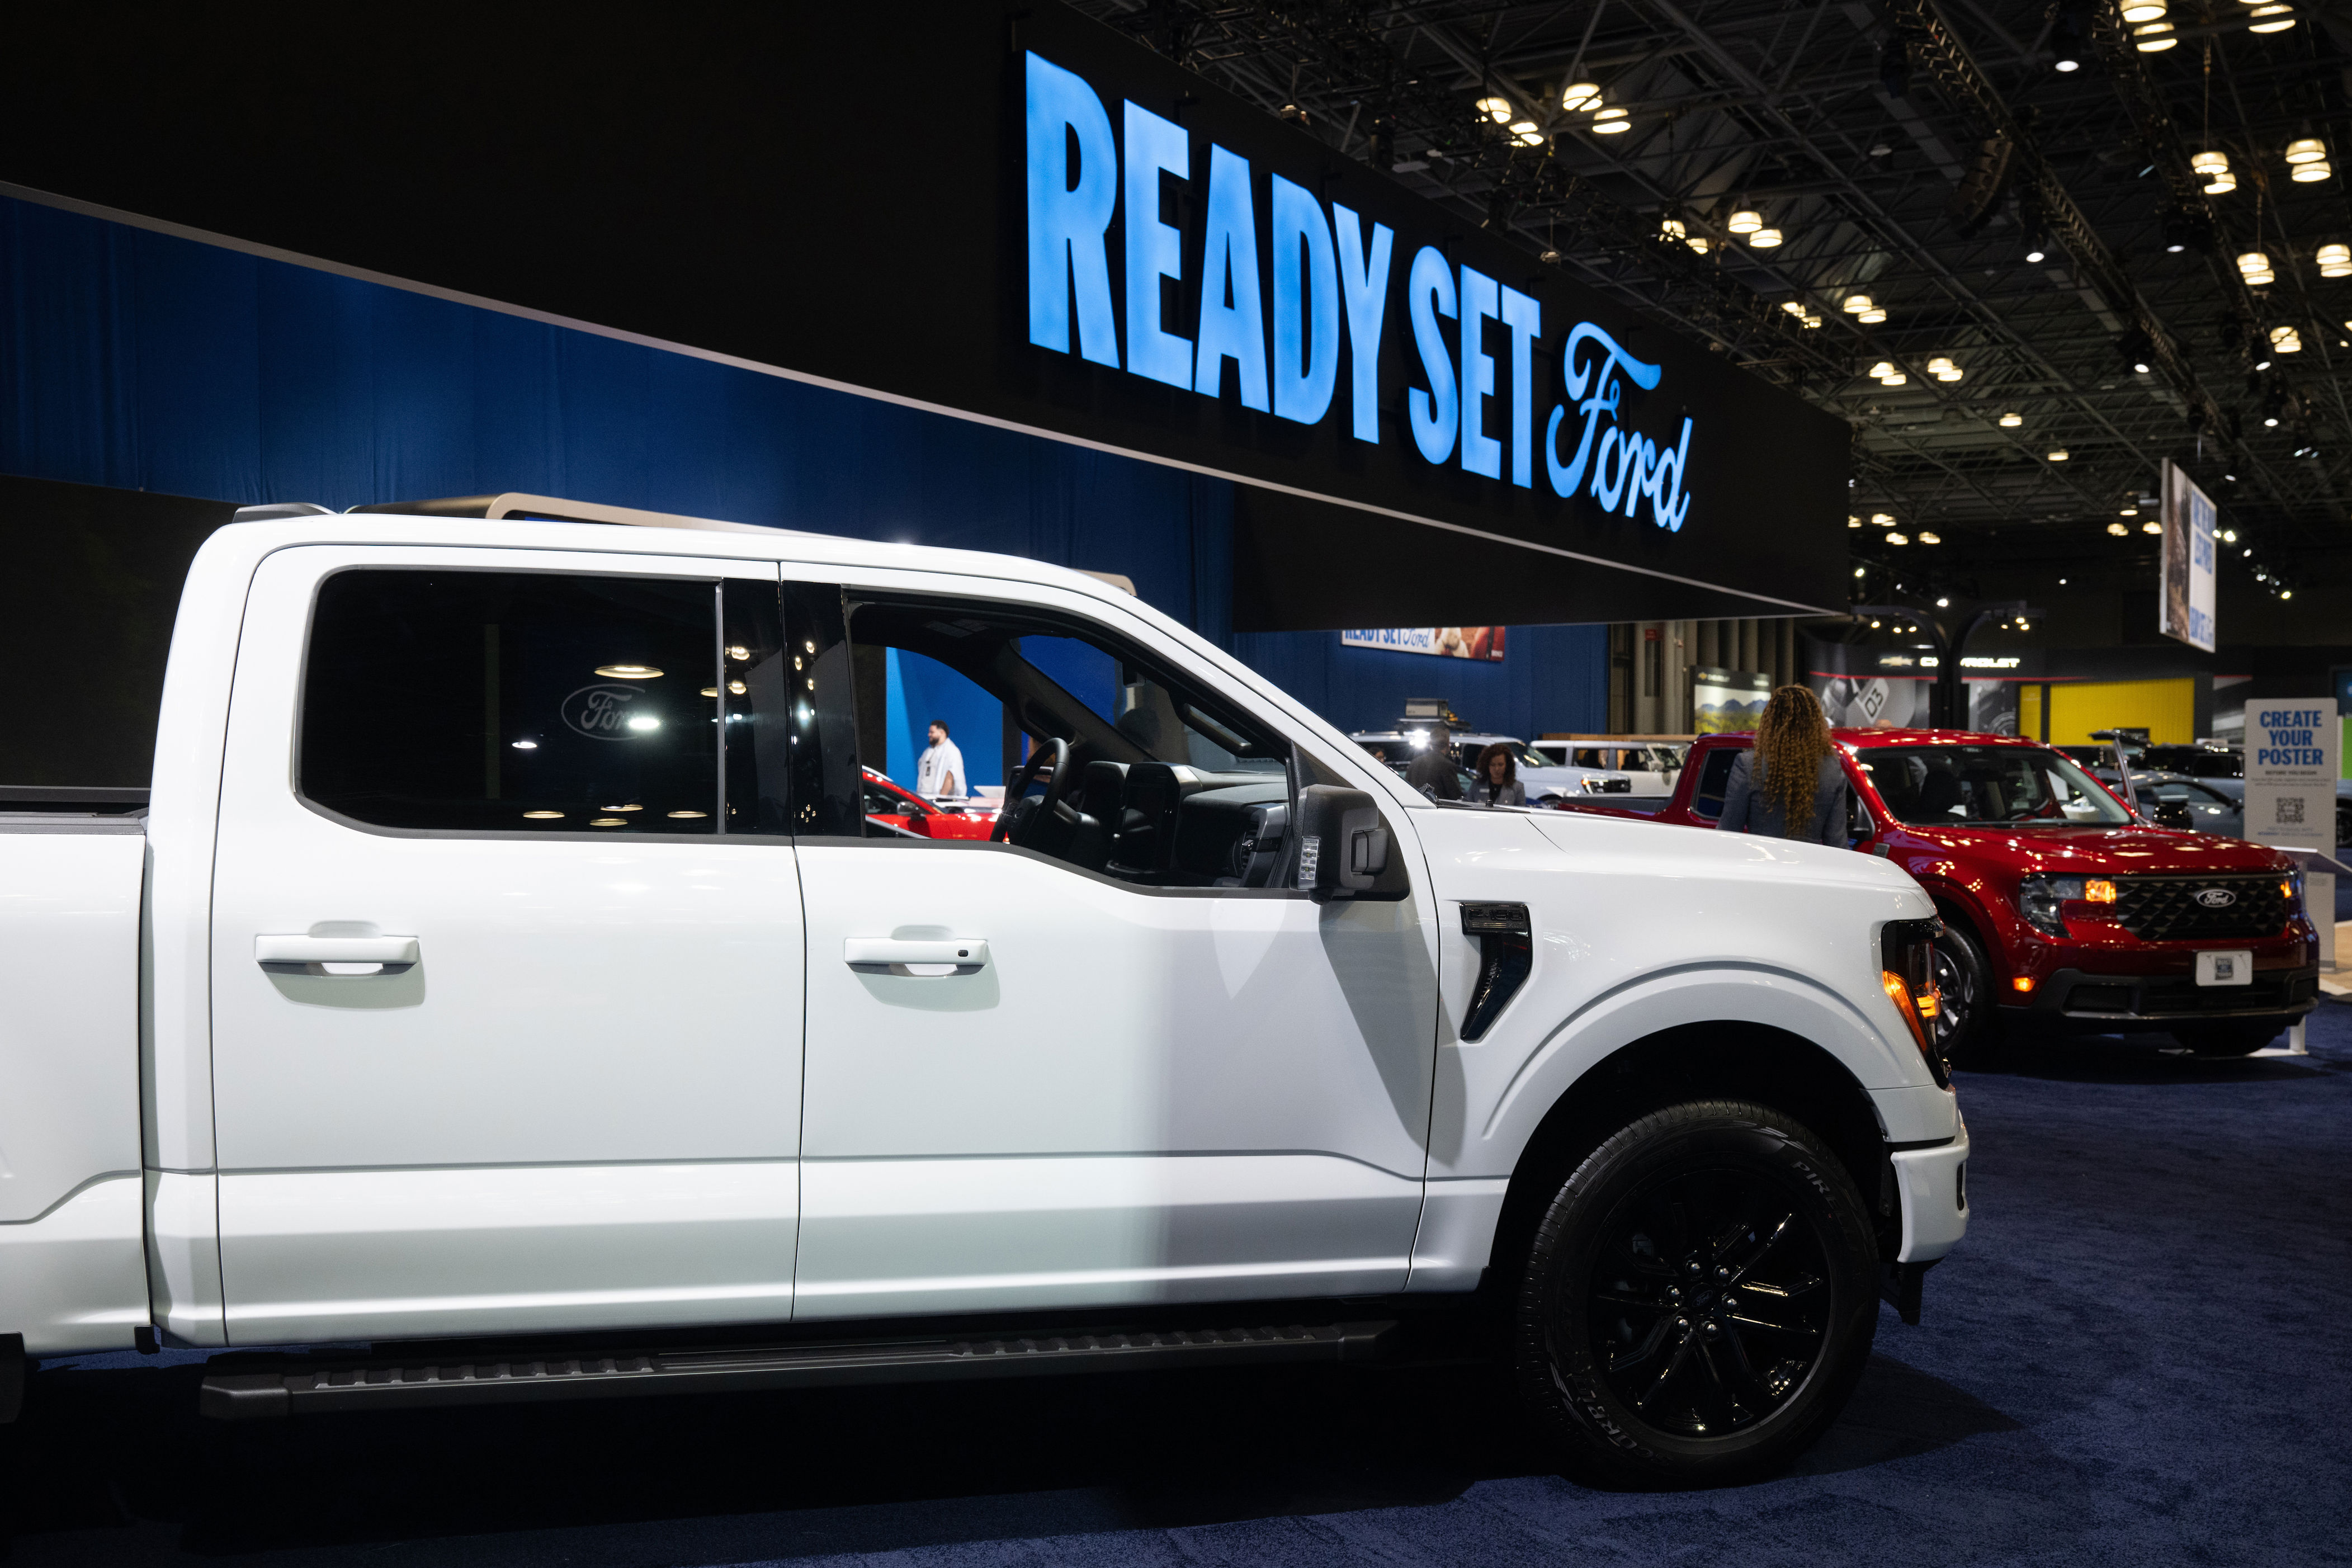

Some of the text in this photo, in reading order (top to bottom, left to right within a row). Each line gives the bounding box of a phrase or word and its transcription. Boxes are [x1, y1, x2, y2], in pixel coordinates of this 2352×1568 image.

[1026, 50, 1693, 533] READY SET Ford
[1920, 657, 2020, 668] CHROLET
[2260, 710, 2322, 728] CREATE
[2269, 729, 2313, 747] YOUR
[2257, 748, 2323, 766] POSTER
[2204, 892, 2230, 904] Ford
